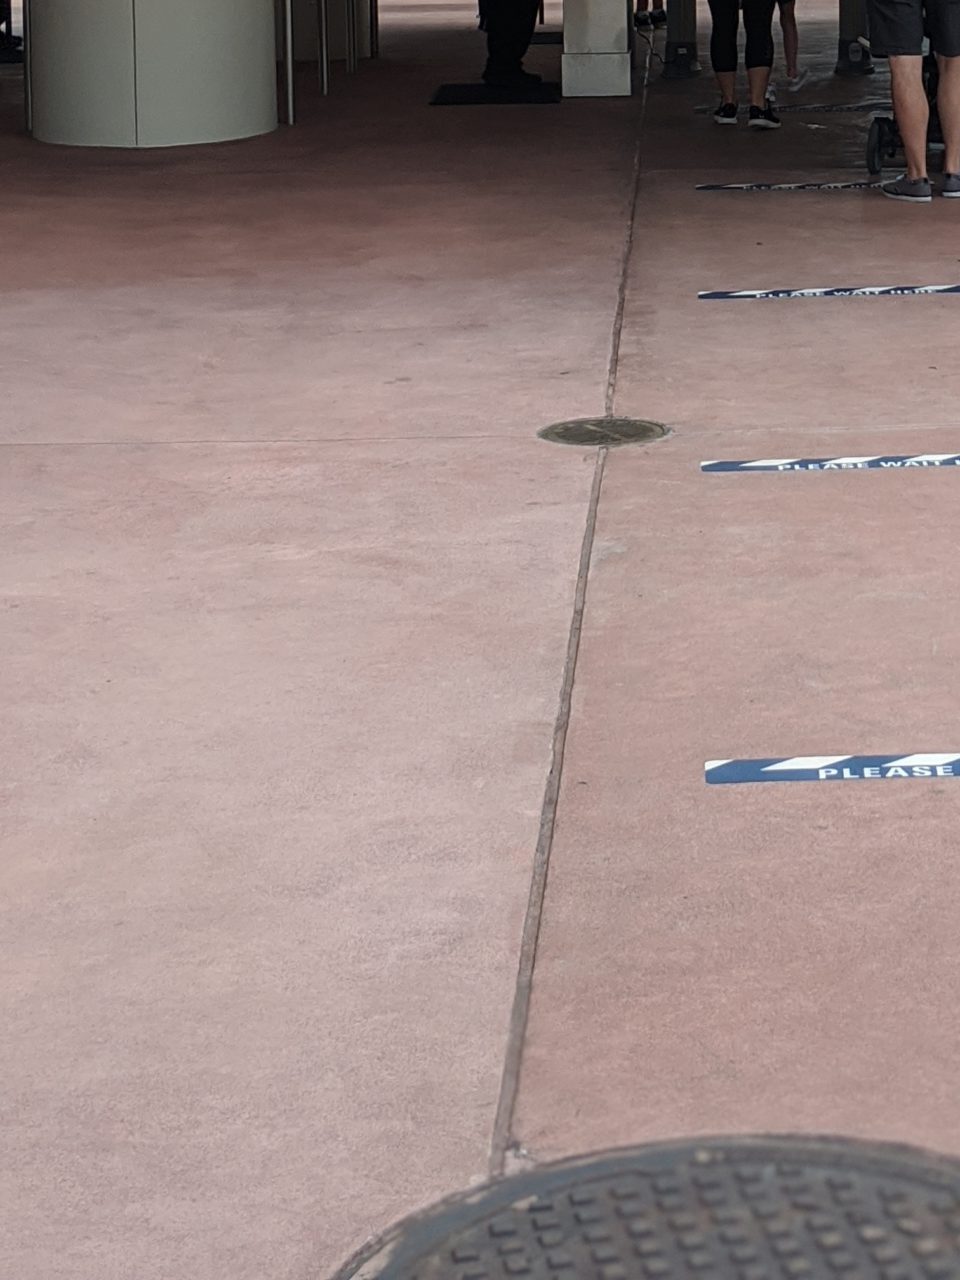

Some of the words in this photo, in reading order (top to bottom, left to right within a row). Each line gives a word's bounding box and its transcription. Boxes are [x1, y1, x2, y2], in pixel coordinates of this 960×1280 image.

[778, 463, 869, 471] PLEASE
[880, 459, 943, 467] WAIT
[818, 765, 954, 779] PLEASE
